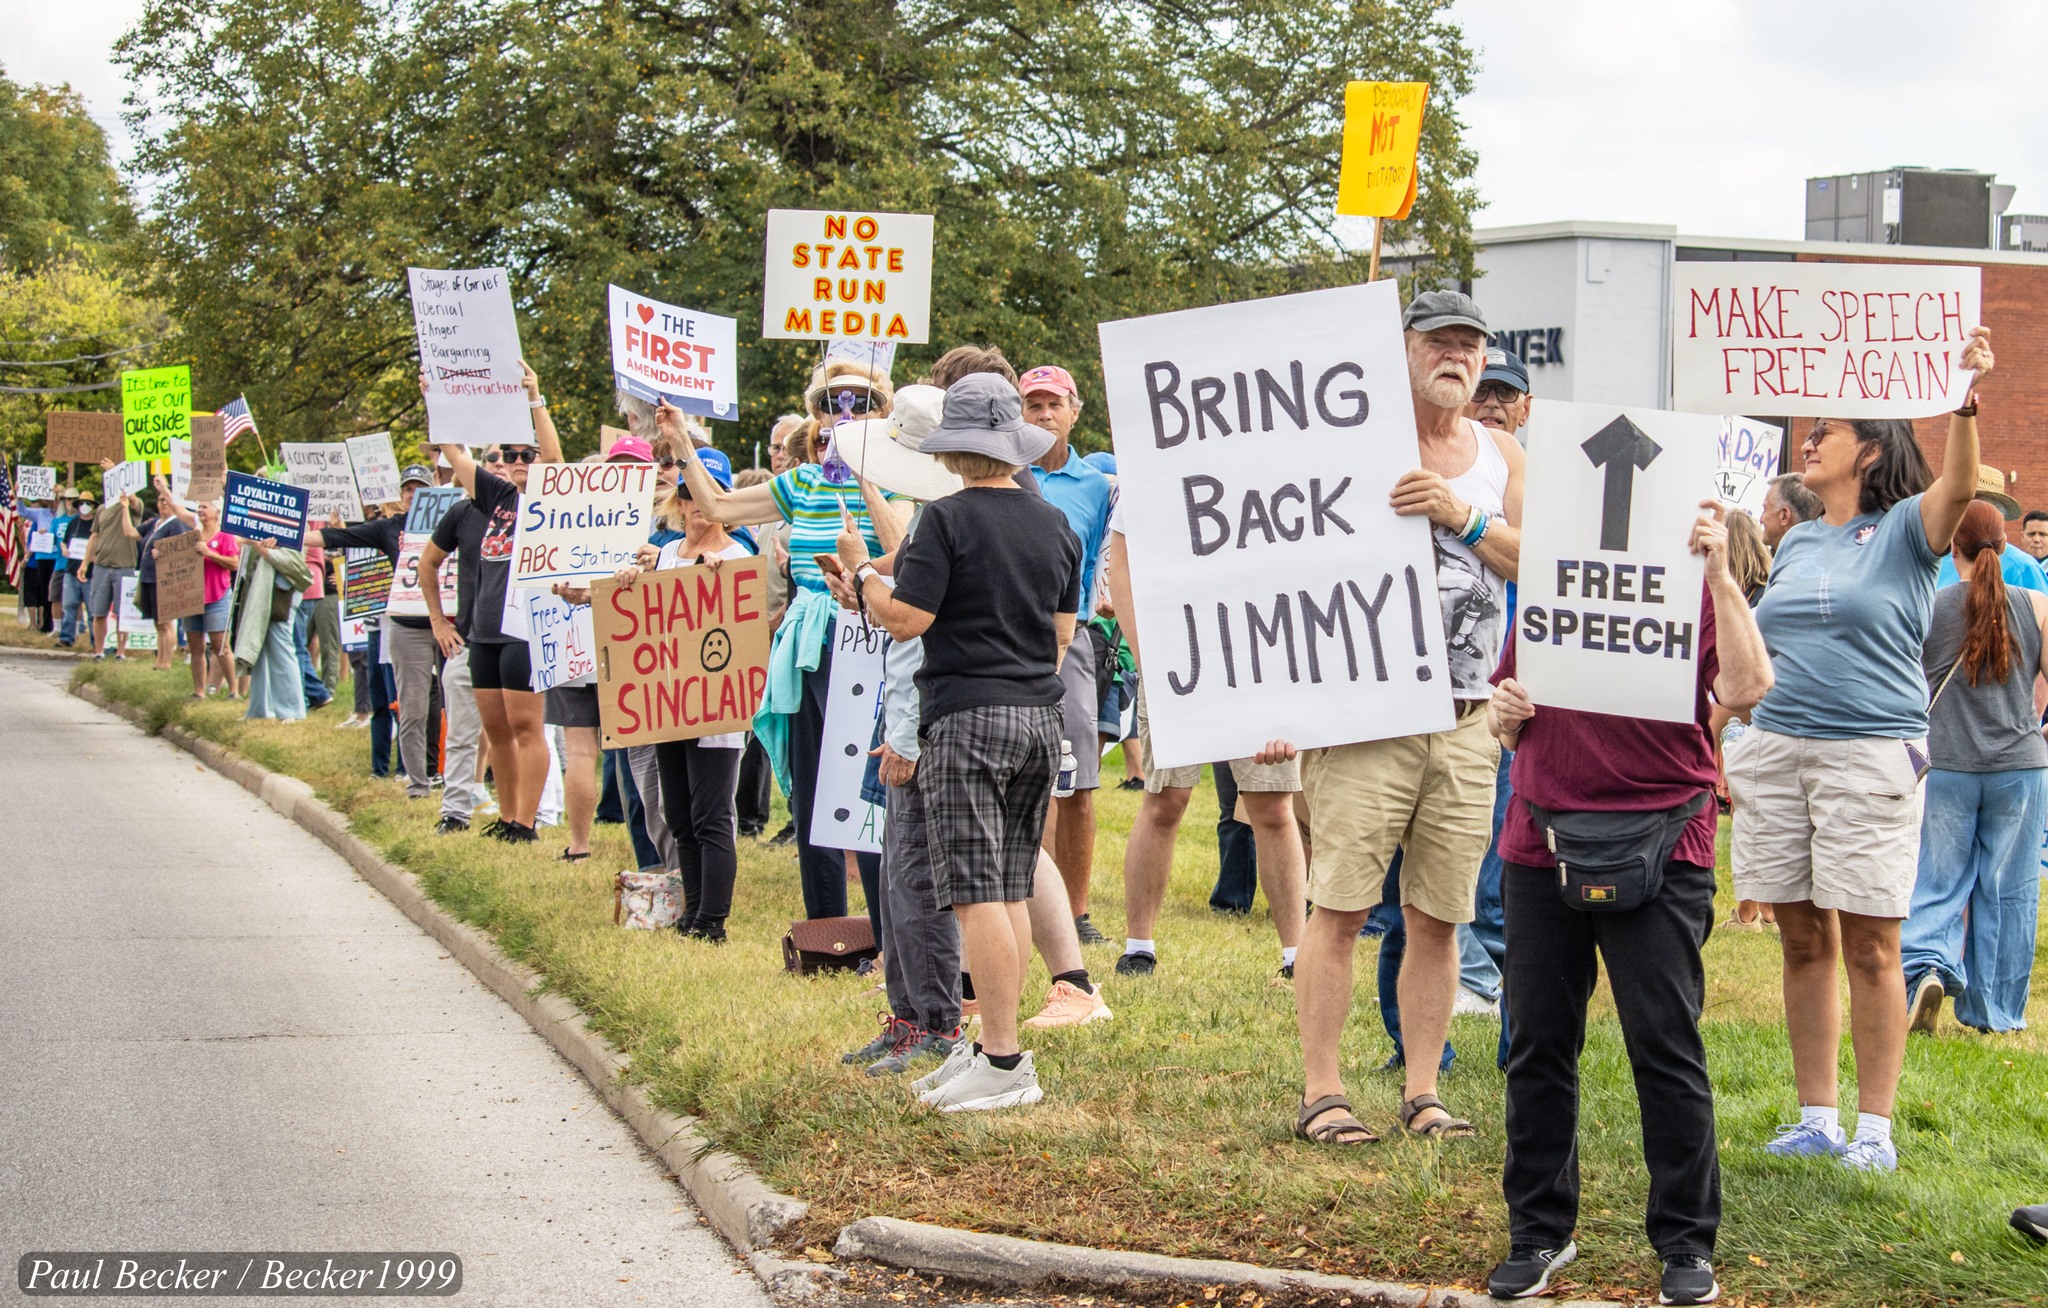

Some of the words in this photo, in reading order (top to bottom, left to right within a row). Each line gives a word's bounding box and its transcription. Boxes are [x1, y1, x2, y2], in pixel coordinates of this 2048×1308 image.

[1369, 112, 1400, 156] NOT
[824, 215, 879, 242] NO
[792, 242, 904, 273] STATE
[420, 272, 449, 297] Stages
[452, 275, 461, 292] of
[464, 273, 500, 292] Grief
[814, 277, 885, 304] RUN
[625, 301, 629, 318] I
[661, 313, 695, 338] THE
[784, 307, 909, 339] MEDIA
[1688, 285, 1803, 340] MAKE
[1820, 290, 1965, 343] SPEECH
[428, 322, 459, 339] Anger
[431, 343, 491, 364] Bargaining
[625, 324, 715, 374] FIRST
[173, 374, 188, 387] to
[626, 358, 715, 392] AMENDMENT
[1722, 346, 1828, 399] FREE
[1838, 348, 1951, 401] AGAIN
[134, 396, 156, 411] use
[163, 392, 190, 407] our
[1144, 359, 1370, 450] BRING
[52, 414, 108, 431] DEFEND
[125, 410, 185, 435] outside
[20, 467, 38, 476] WAKE
[105, 461, 142, 500] BOYCOTT
[542, 464, 653, 496] BOYCOTT
[230, 494, 246, 506] THE
[246, 499, 302, 520] CONSTITUTION
[237, 483, 281, 504] LOYALTY
[282, 494, 297, 508] TO
[226, 513, 242, 526] NOT
[243, 517, 258, 530] THE
[258, 522, 299, 540] PRESIDENT
[525, 502, 639, 532] Sinclair's
[1182, 474, 1356, 557] BACK
[518, 543, 559, 573] ABC
[1557, 559, 1666, 604] FREE
[530, 596, 560, 635] Free
[610, 569, 759, 642] SHAME
[541, 633, 559, 664] For
[565, 625, 585, 659] ALL
[1167, 564, 1433, 697] JIMMY!
[1522, 605, 1692, 661] SPEECH
[568, 659, 593, 680] some
[633, 637, 679, 676] ON
[617, 665, 767, 734] SINCLAIR
